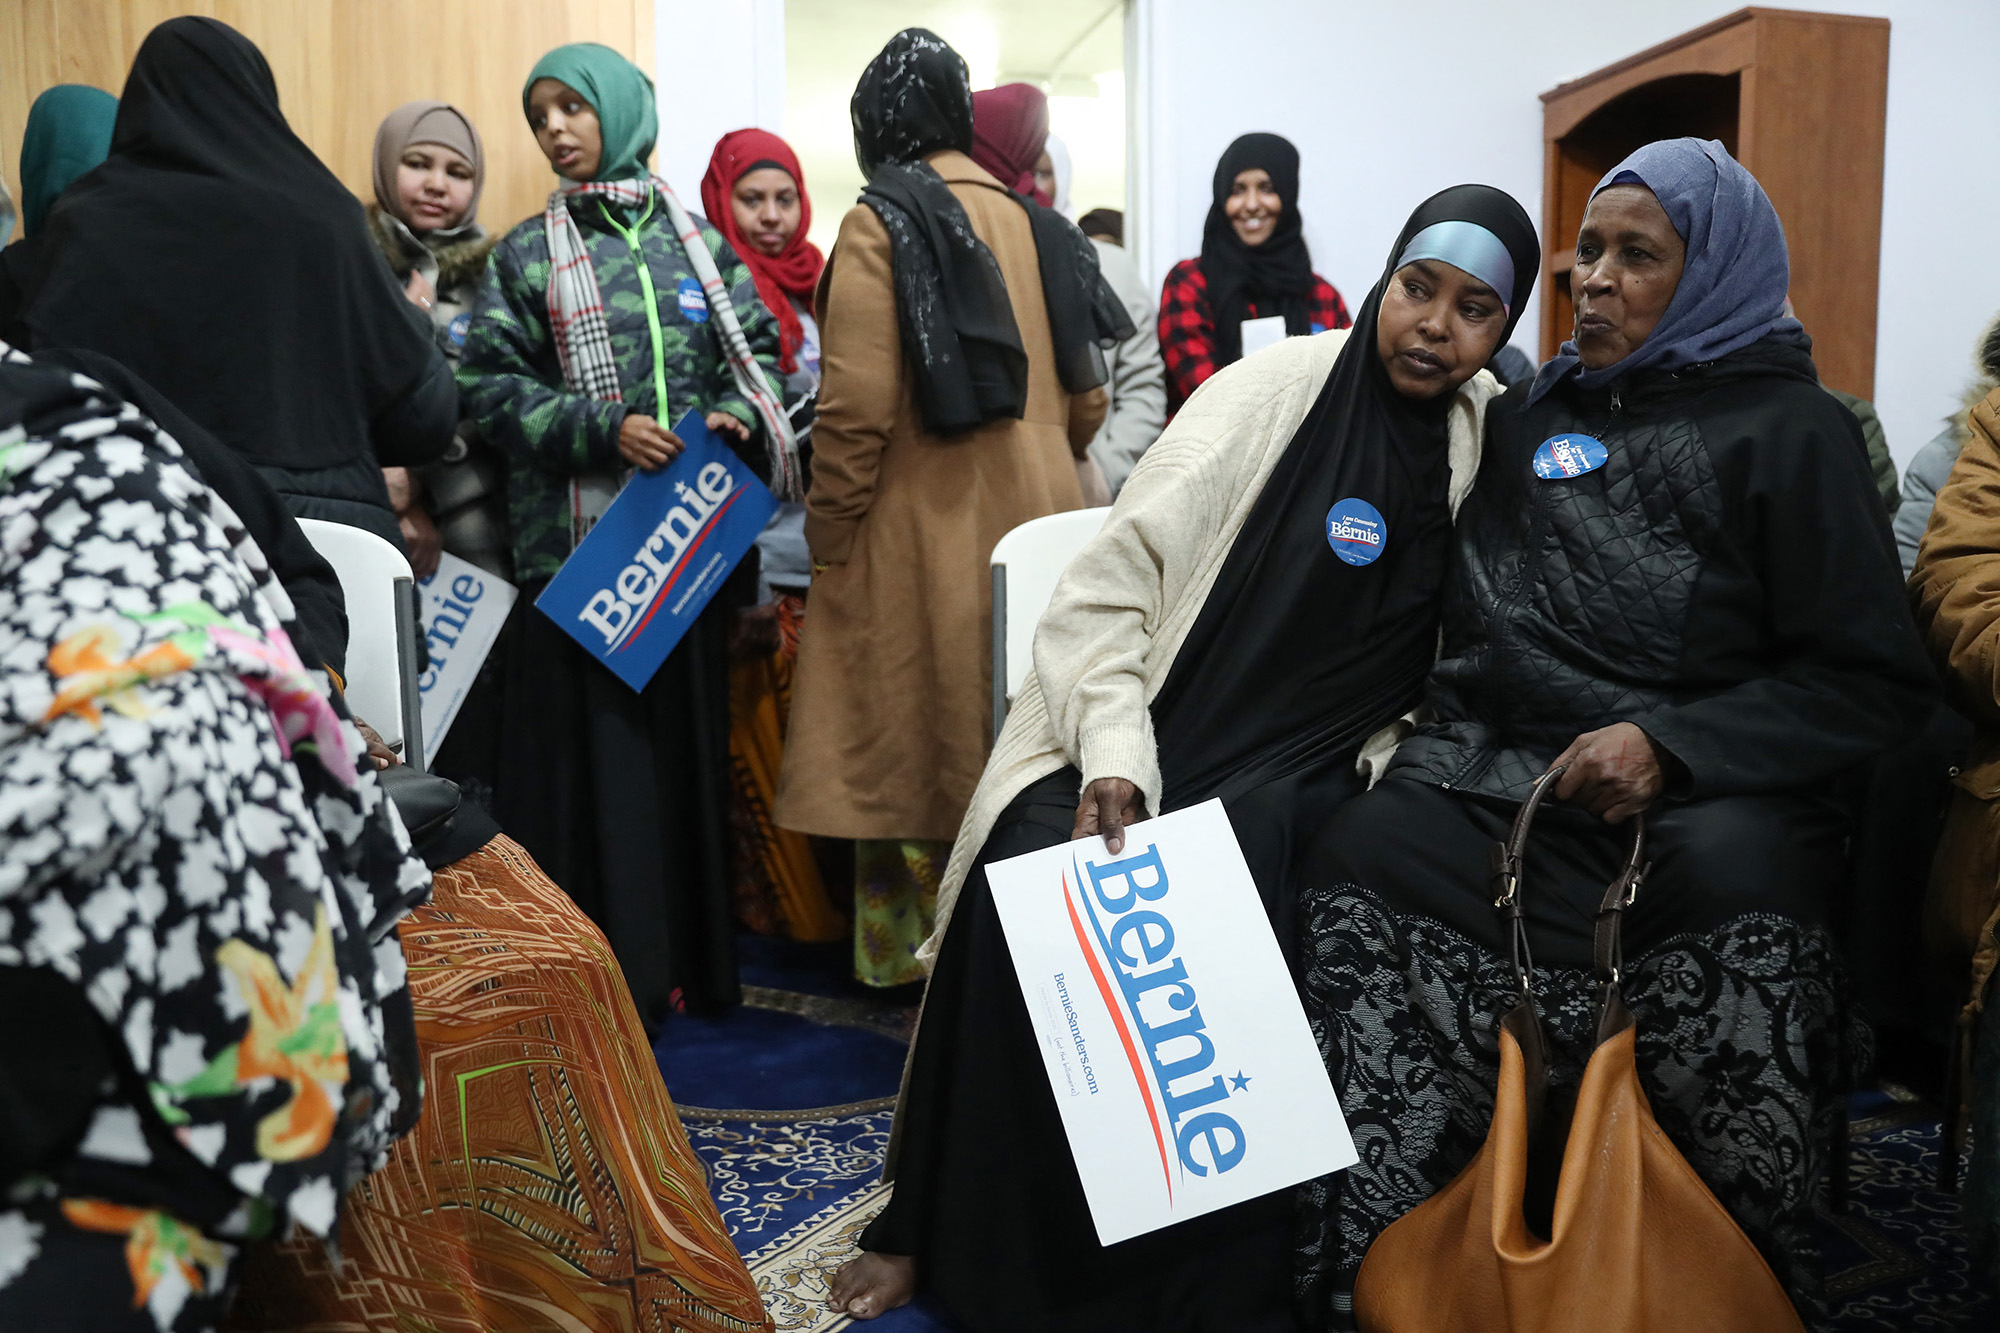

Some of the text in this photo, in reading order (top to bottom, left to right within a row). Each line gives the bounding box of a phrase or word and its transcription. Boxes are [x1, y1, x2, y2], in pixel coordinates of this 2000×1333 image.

[1554, 439, 1581, 475] Bernie
[577, 461, 734, 645] Bernie
[1330, 521, 1380, 544] Bernie
[1053, 972, 1099, 1095] BernieSanders.com
[1085, 843, 1247, 1178] Bernie
